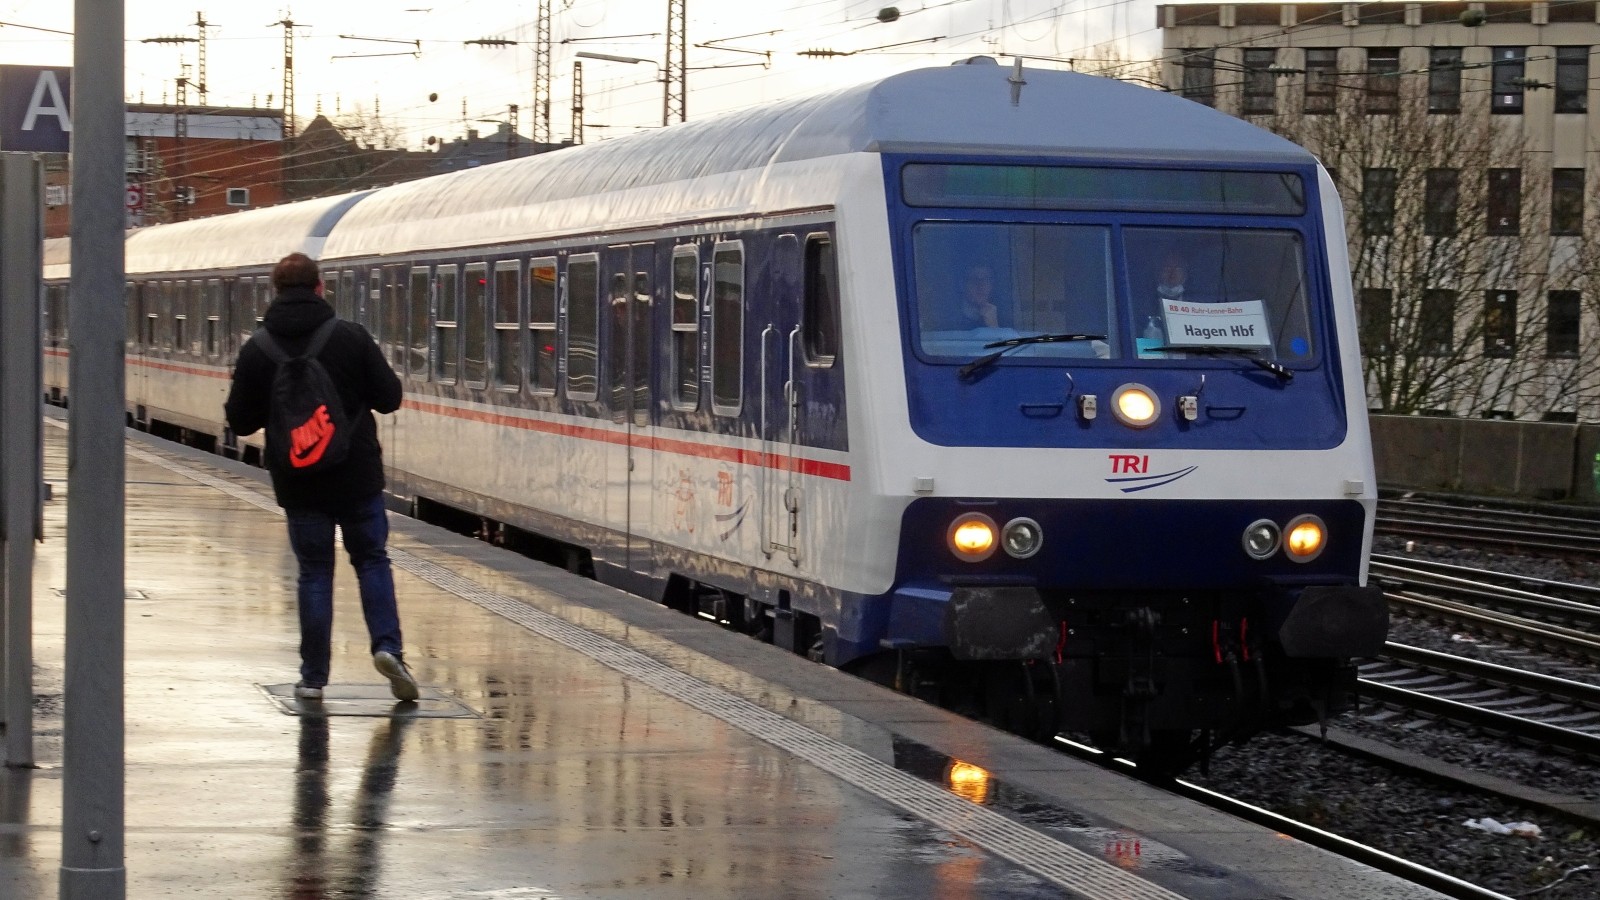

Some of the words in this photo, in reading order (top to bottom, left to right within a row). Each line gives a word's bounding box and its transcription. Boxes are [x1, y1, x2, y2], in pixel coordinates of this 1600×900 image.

[21, 70, 72, 132] A
[1169, 304, 1178, 312] RB
[1184, 324, 1227, 339] Hagen
[1230, 324, 1254, 337] Hbf
[1108, 454, 1149, 474] TRI
